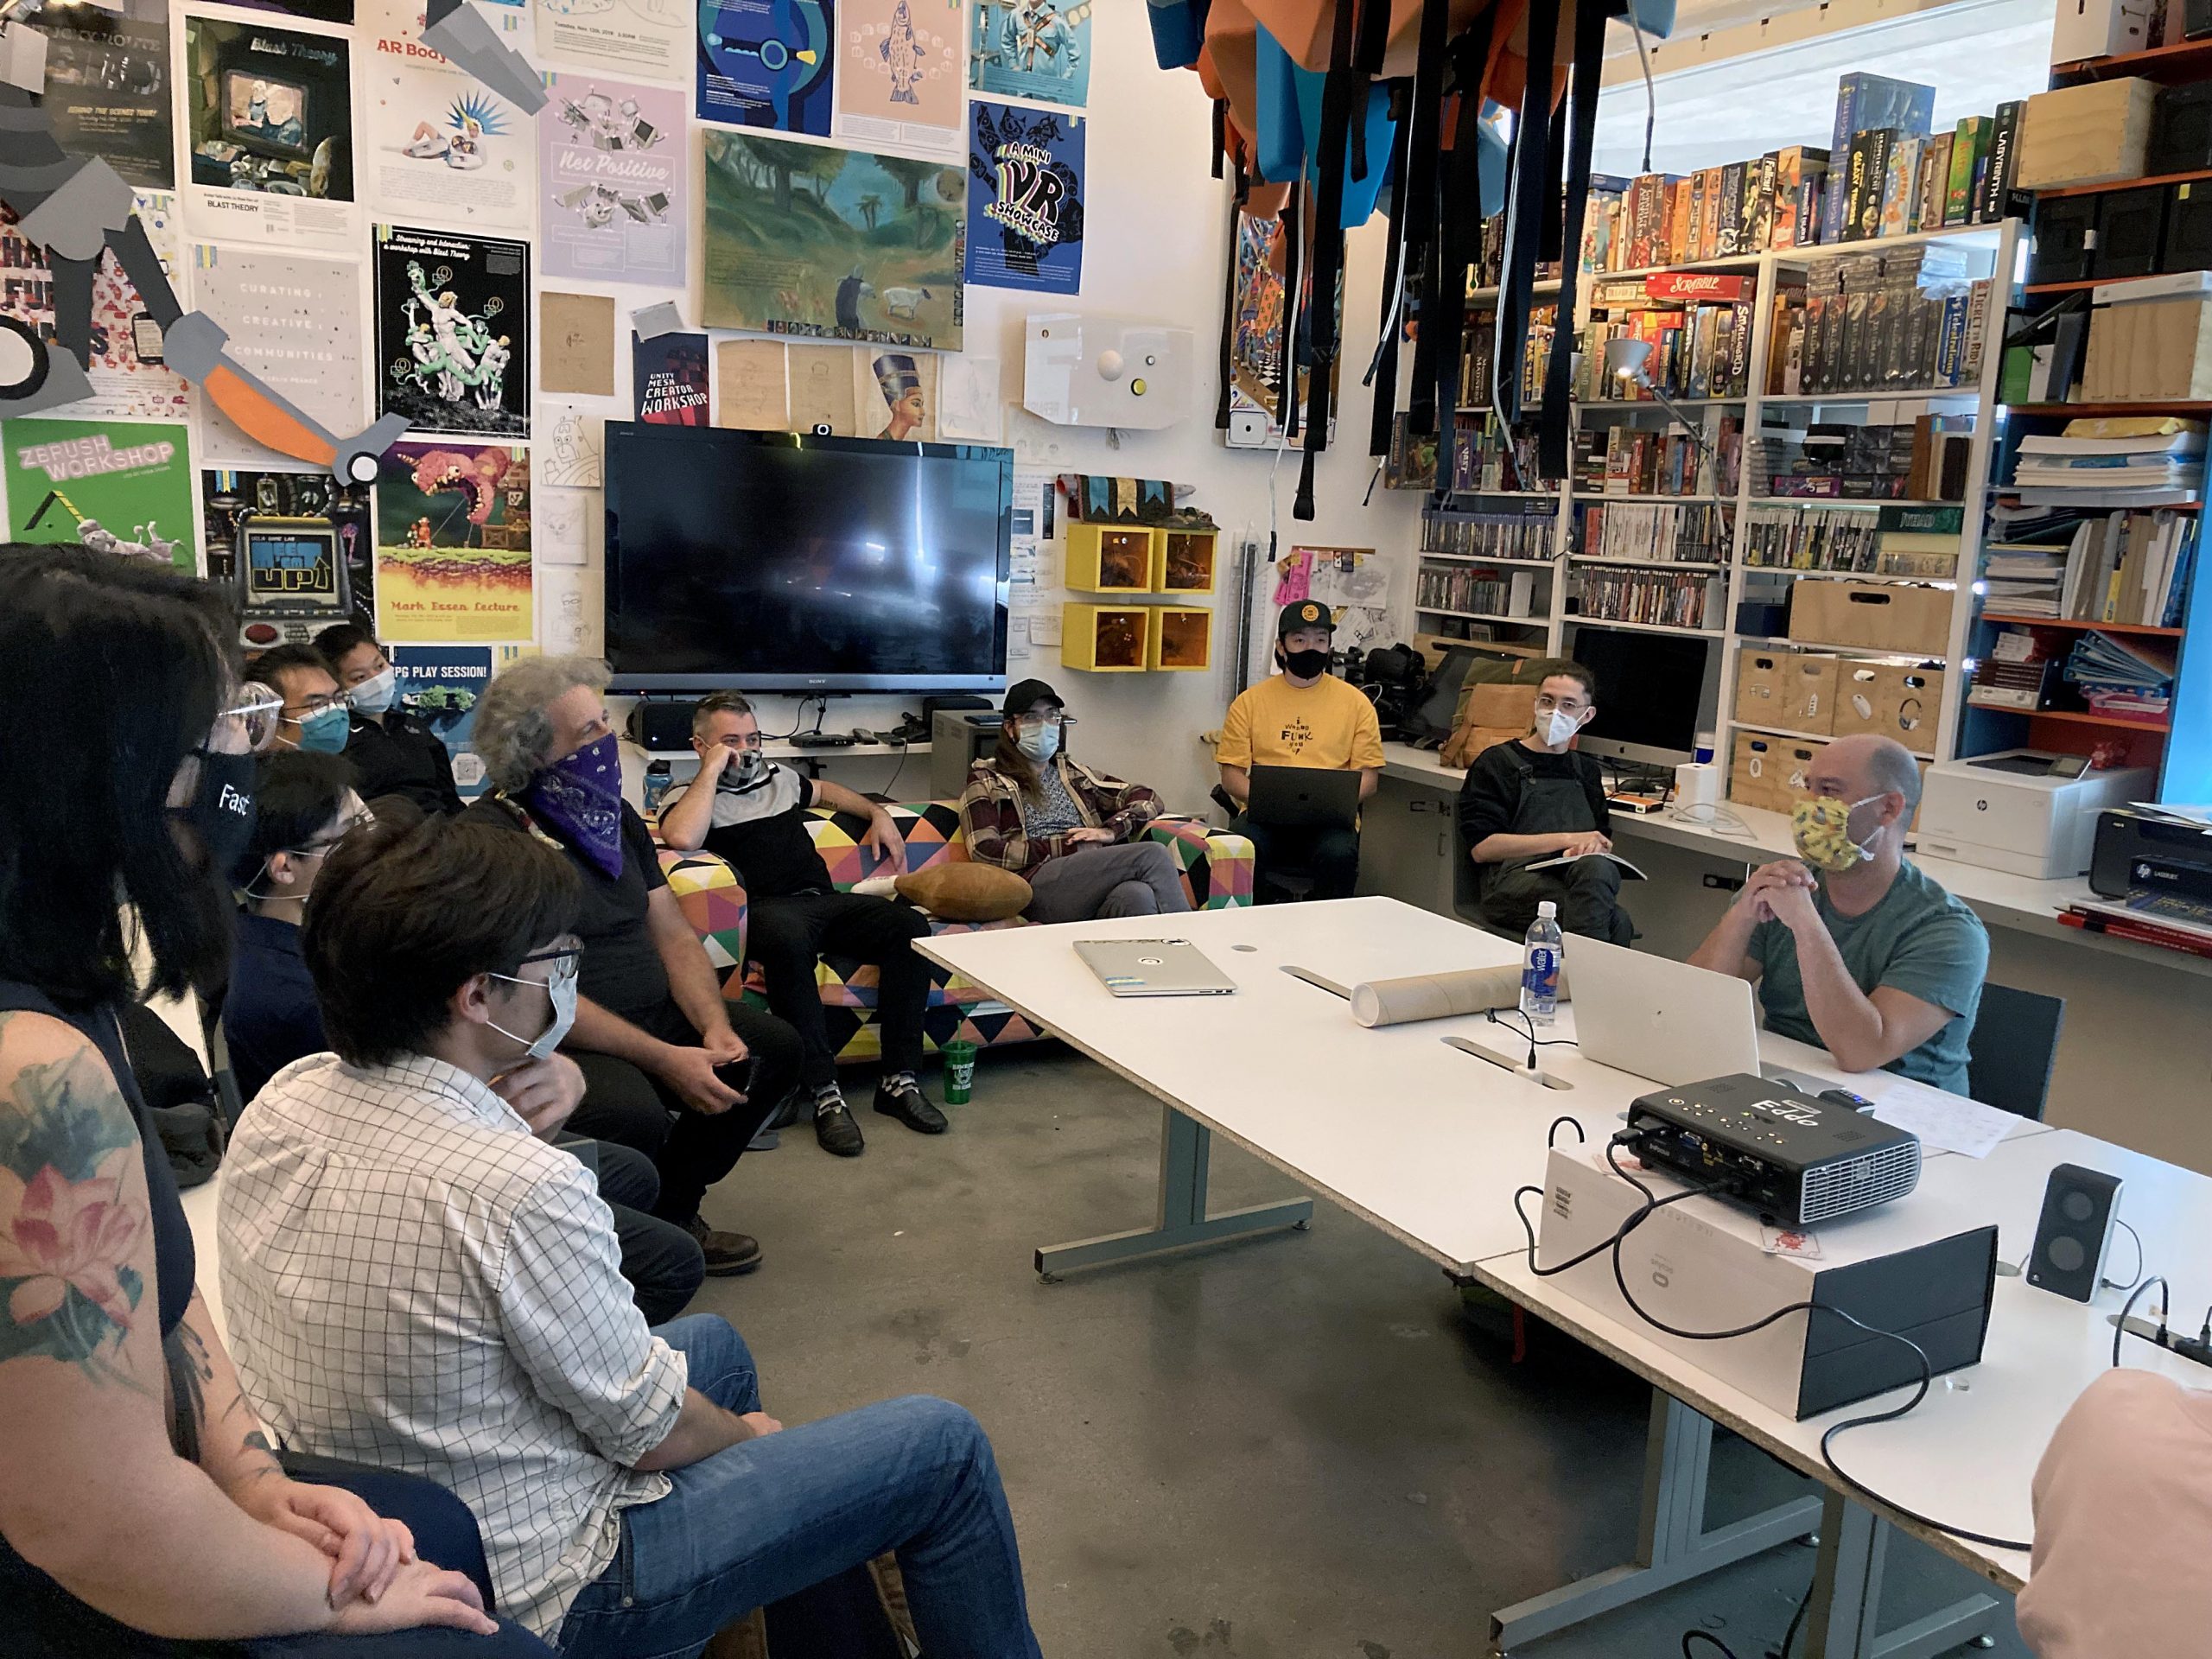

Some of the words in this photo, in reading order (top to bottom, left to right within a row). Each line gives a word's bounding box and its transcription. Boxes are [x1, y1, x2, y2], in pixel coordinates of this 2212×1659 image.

[251, 37, 287, 55] Blast
[377, 39, 403, 54] AR
[406, 42, 447, 63] Body
[1012, 142, 1020, 156] A
[1022, 144, 1052, 164] MINI
[1989, 130, 2008, 197] LABYRINTH
[560, 150, 594, 171] Net
[596, 155, 670, 180] Positive
[1763, 160, 1776, 192] Fallout
[1853, 151, 1863, 185] GALAXY
[1009, 160, 1065, 225] VR
[231, 202, 258, 212] THEORY
[996, 201, 1060, 242] SHOWCASE
[240, 283, 312, 298] CURATING
[1670, 276, 1719, 294] SCRABBLE
[243, 315, 312, 329] CREATIVE
[234, 346, 334, 361] COMMUNITIES
[1969, 342, 1982, 366] RIDE
[645, 385, 694, 398] CREATOR
[648, 378, 675, 387] MESH
[640, 392, 708, 416] WORKSHOP
[46, 444, 173, 479] WORKSHOP
[391, 601, 424, 612] Mark
[431, 601, 468, 612] Essen
[474, 601, 520, 612] Lecture
[394, 666, 409, 677] PG
[412, 666, 437, 677] PLAY
[441, 666, 486, 677] SESSION!
[219, 784, 250, 817] Fast
[1536, 950, 1548, 972] water
